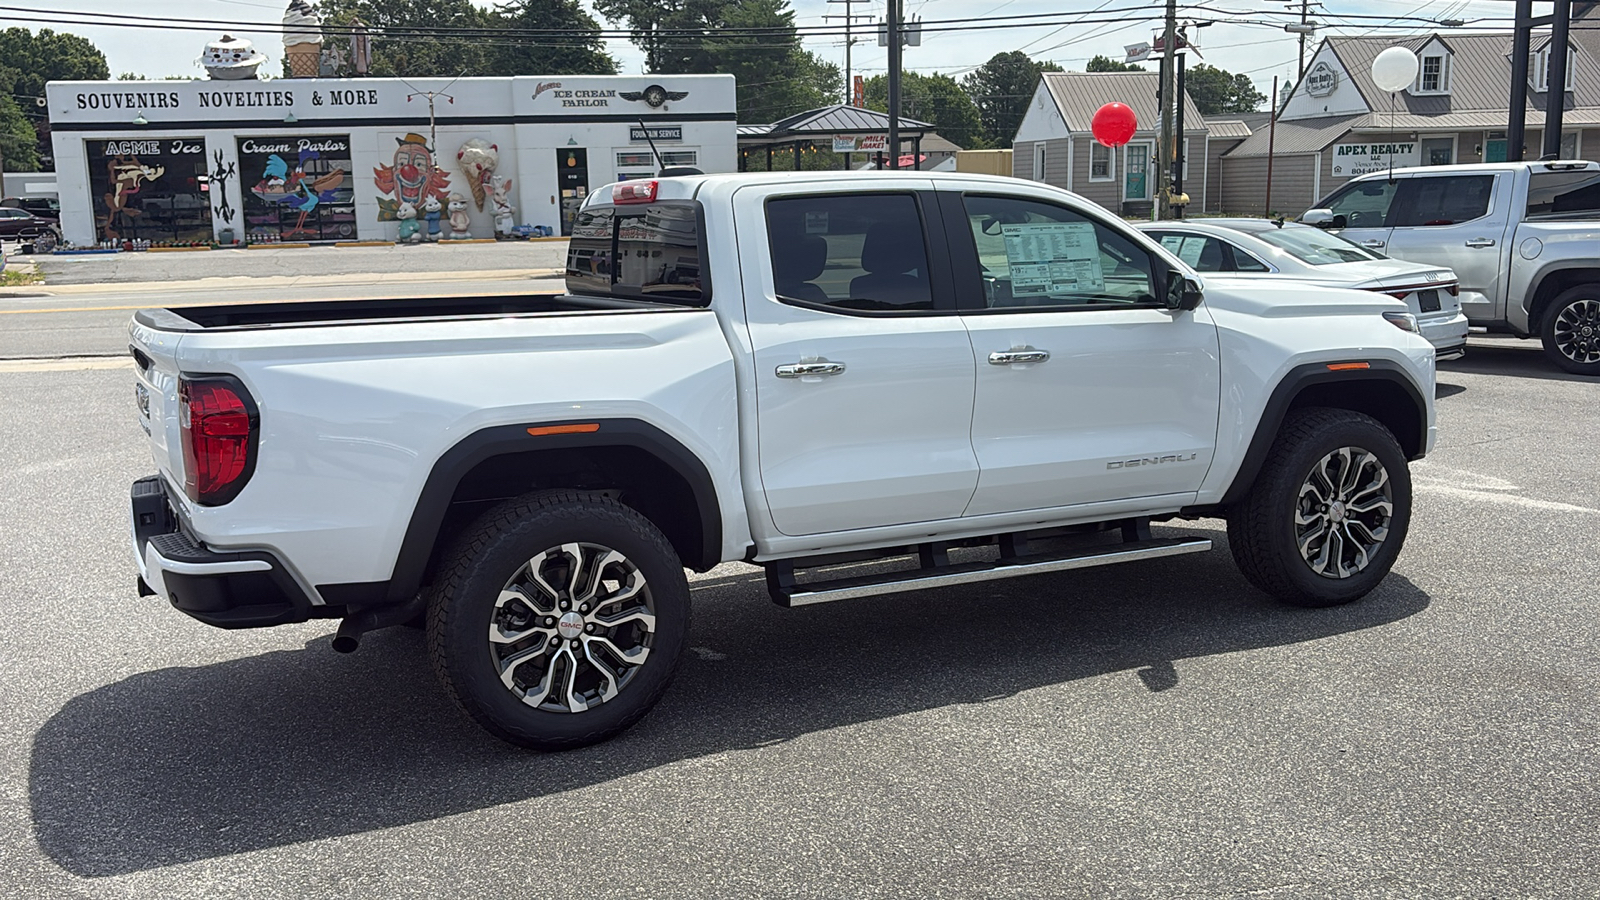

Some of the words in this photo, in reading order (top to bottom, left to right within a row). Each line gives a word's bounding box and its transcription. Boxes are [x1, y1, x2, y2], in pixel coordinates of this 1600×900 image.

[77, 92, 180, 109] SOUVENIRS
[198, 91, 294, 107] NOVELTIES
[311, 90, 324, 106] &
[330, 90, 378, 105] MORE
[553, 90, 573, 98] ICE
[575, 90, 616, 98] CREAM
[562, 99, 608, 107] PARLOR
[658, 130, 681, 138] SERVICE
[105, 141, 160, 155] ACME
[170, 140, 203, 154] Ice
[242, 140, 291, 153] Cream
[297, 139, 347, 152] Parlor
[1337, 145, 1368, 155] APEX
[1371, 143, 1414, 154] REALTY
[1106, 452, 1197, 470] DENALI
